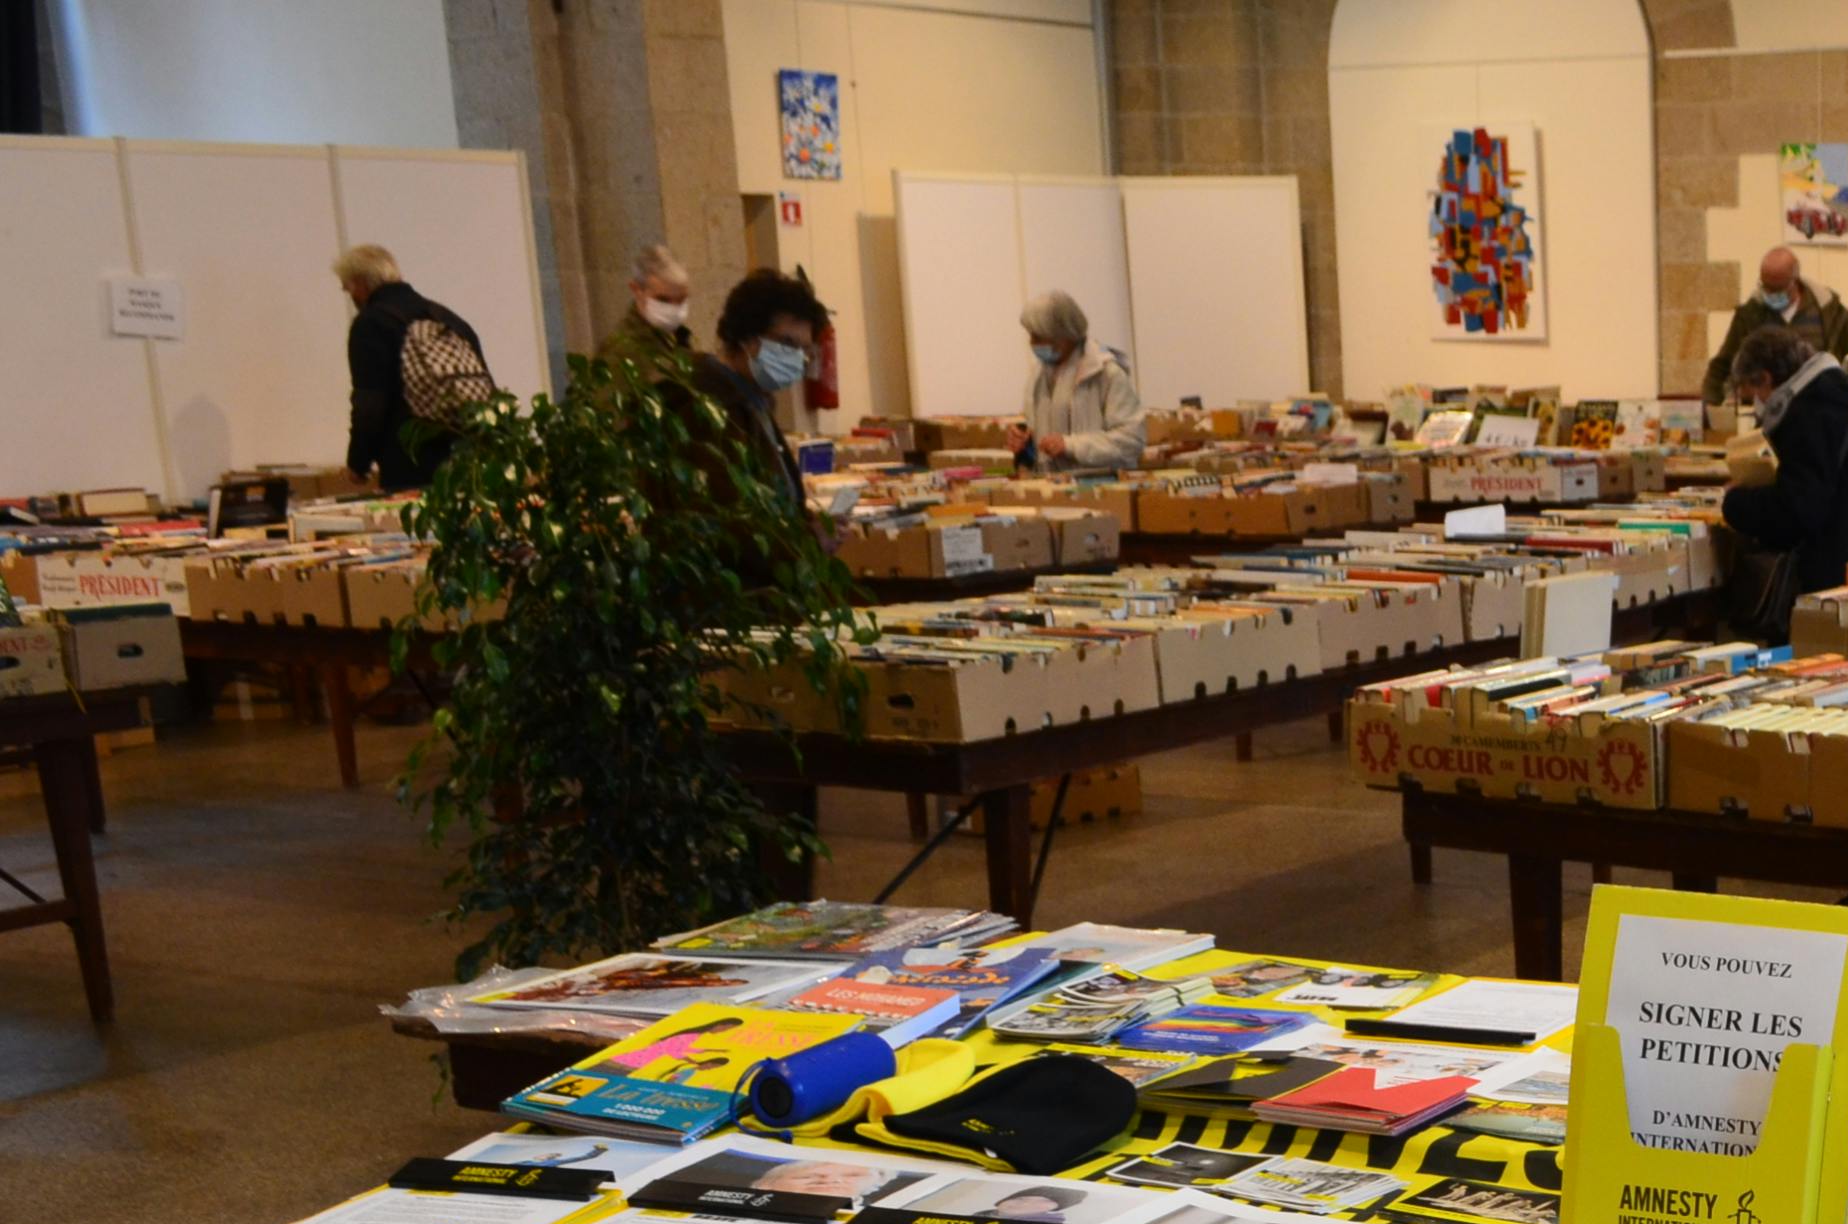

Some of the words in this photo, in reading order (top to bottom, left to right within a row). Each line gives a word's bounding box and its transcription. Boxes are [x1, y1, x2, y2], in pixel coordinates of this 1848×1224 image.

[1500, 760, 1514, 771] DE
[1523, 753, 1590, 783] LION
[1661, 952, 1711, 971] VOUS
[1716, 957, 1793, 979] POUVEZ
[1639, 1001, 1742, 1032] SIGNER
[1752, 1012, 1803, 1038] LES
[1652, 1109, 1762, 1136] D'AMNESTY
[458, 1166, 519, 1178] AMNESTY
[704, 1189, 755, 1200] AMNESTY
[1619, 1184, 1718, 1220] AMNESTY
